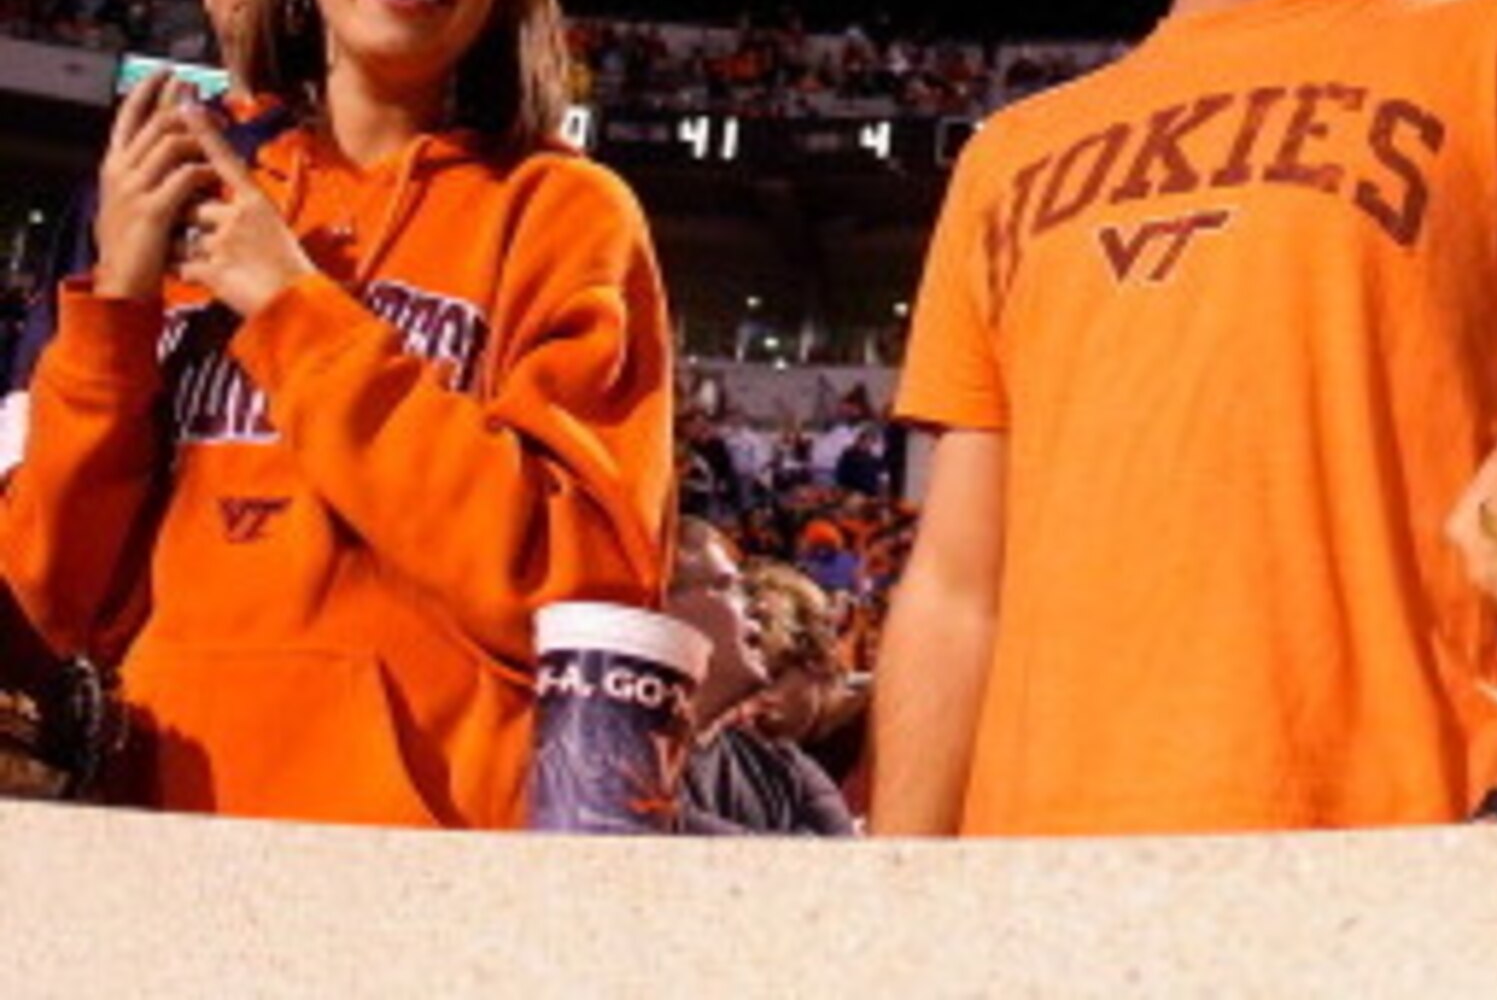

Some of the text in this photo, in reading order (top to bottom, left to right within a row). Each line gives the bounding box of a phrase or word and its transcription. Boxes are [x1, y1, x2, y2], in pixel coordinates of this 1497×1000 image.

[677, 115, 739, 161] 41
[859, 120, 892, 160] 4
[984, 82, 1446, 328] HOKIES
[1099, 210, 1231, 283] VT
[217, 497, 293, 544] VT
